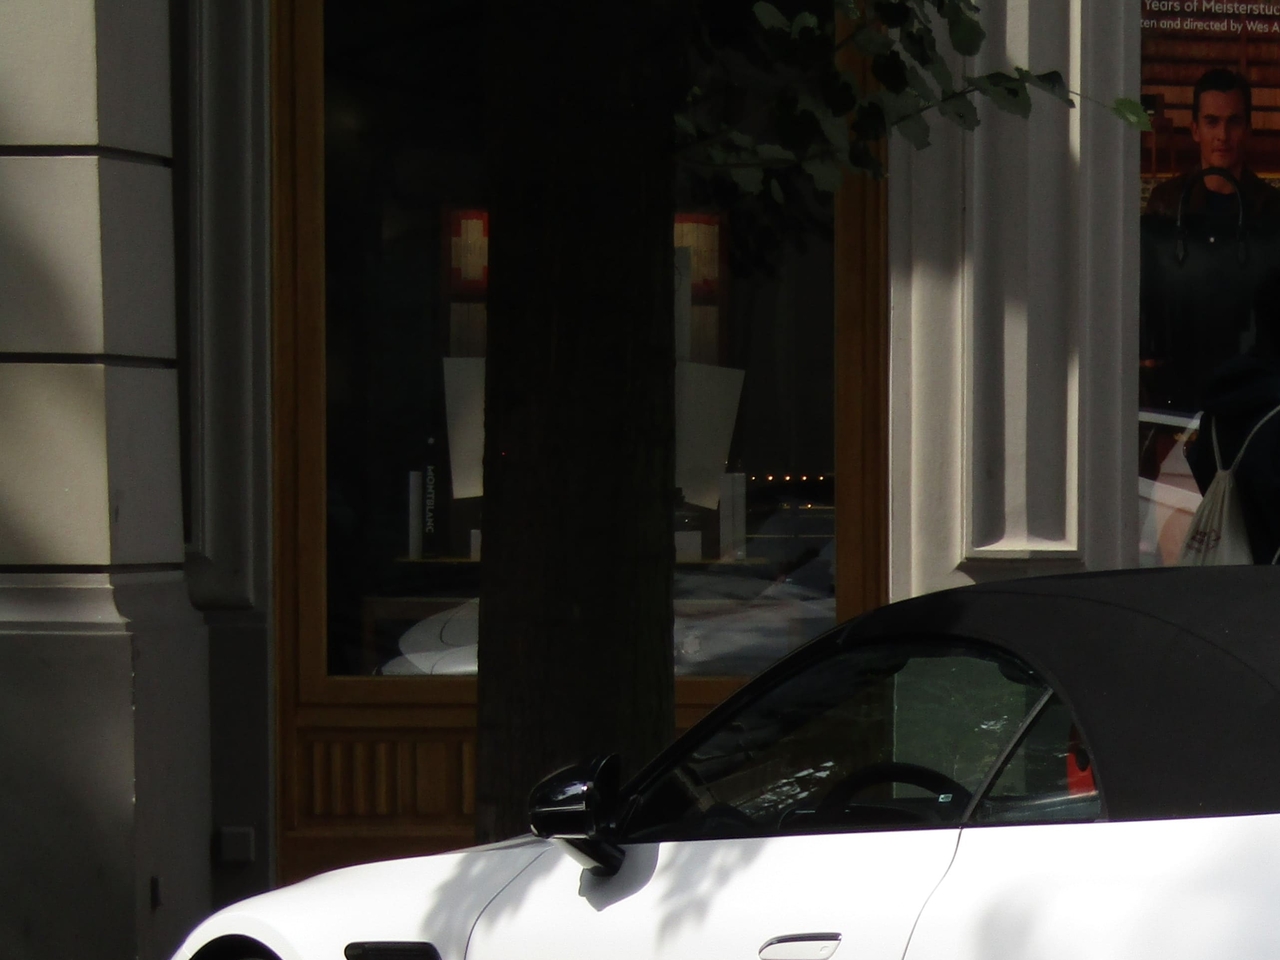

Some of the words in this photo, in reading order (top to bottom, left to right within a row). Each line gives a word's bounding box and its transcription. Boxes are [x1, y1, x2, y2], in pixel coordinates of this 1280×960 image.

[1145, 0, 1180, 12] Years
[1184, 0, 1199, 12] of
[1160, 18, 1180, 29] and
[1184, 18, 1228, 31] directed
[1230, 20, 1243, 34] by
[1246, 20, 1269, 33] Wes
[425, 465, 435, 533] MONTBLANC
